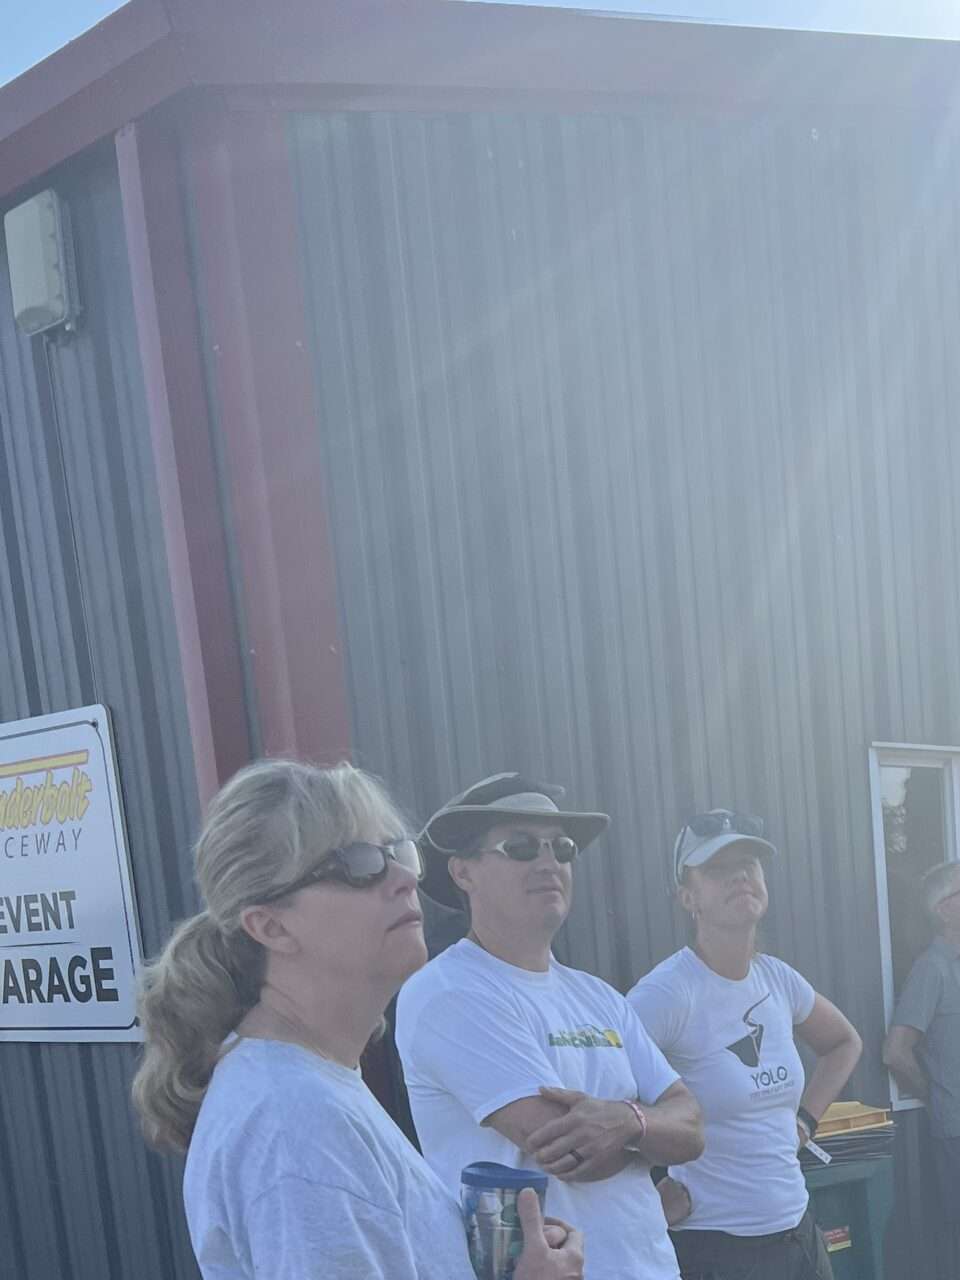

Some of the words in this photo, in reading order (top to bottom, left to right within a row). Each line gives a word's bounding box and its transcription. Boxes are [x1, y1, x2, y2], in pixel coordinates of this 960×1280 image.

[4, 827, 82, 859] CEWAY
[2, 946, 119, 1004] ARAGE
[750, 1065, 788, 1089] YOLO
